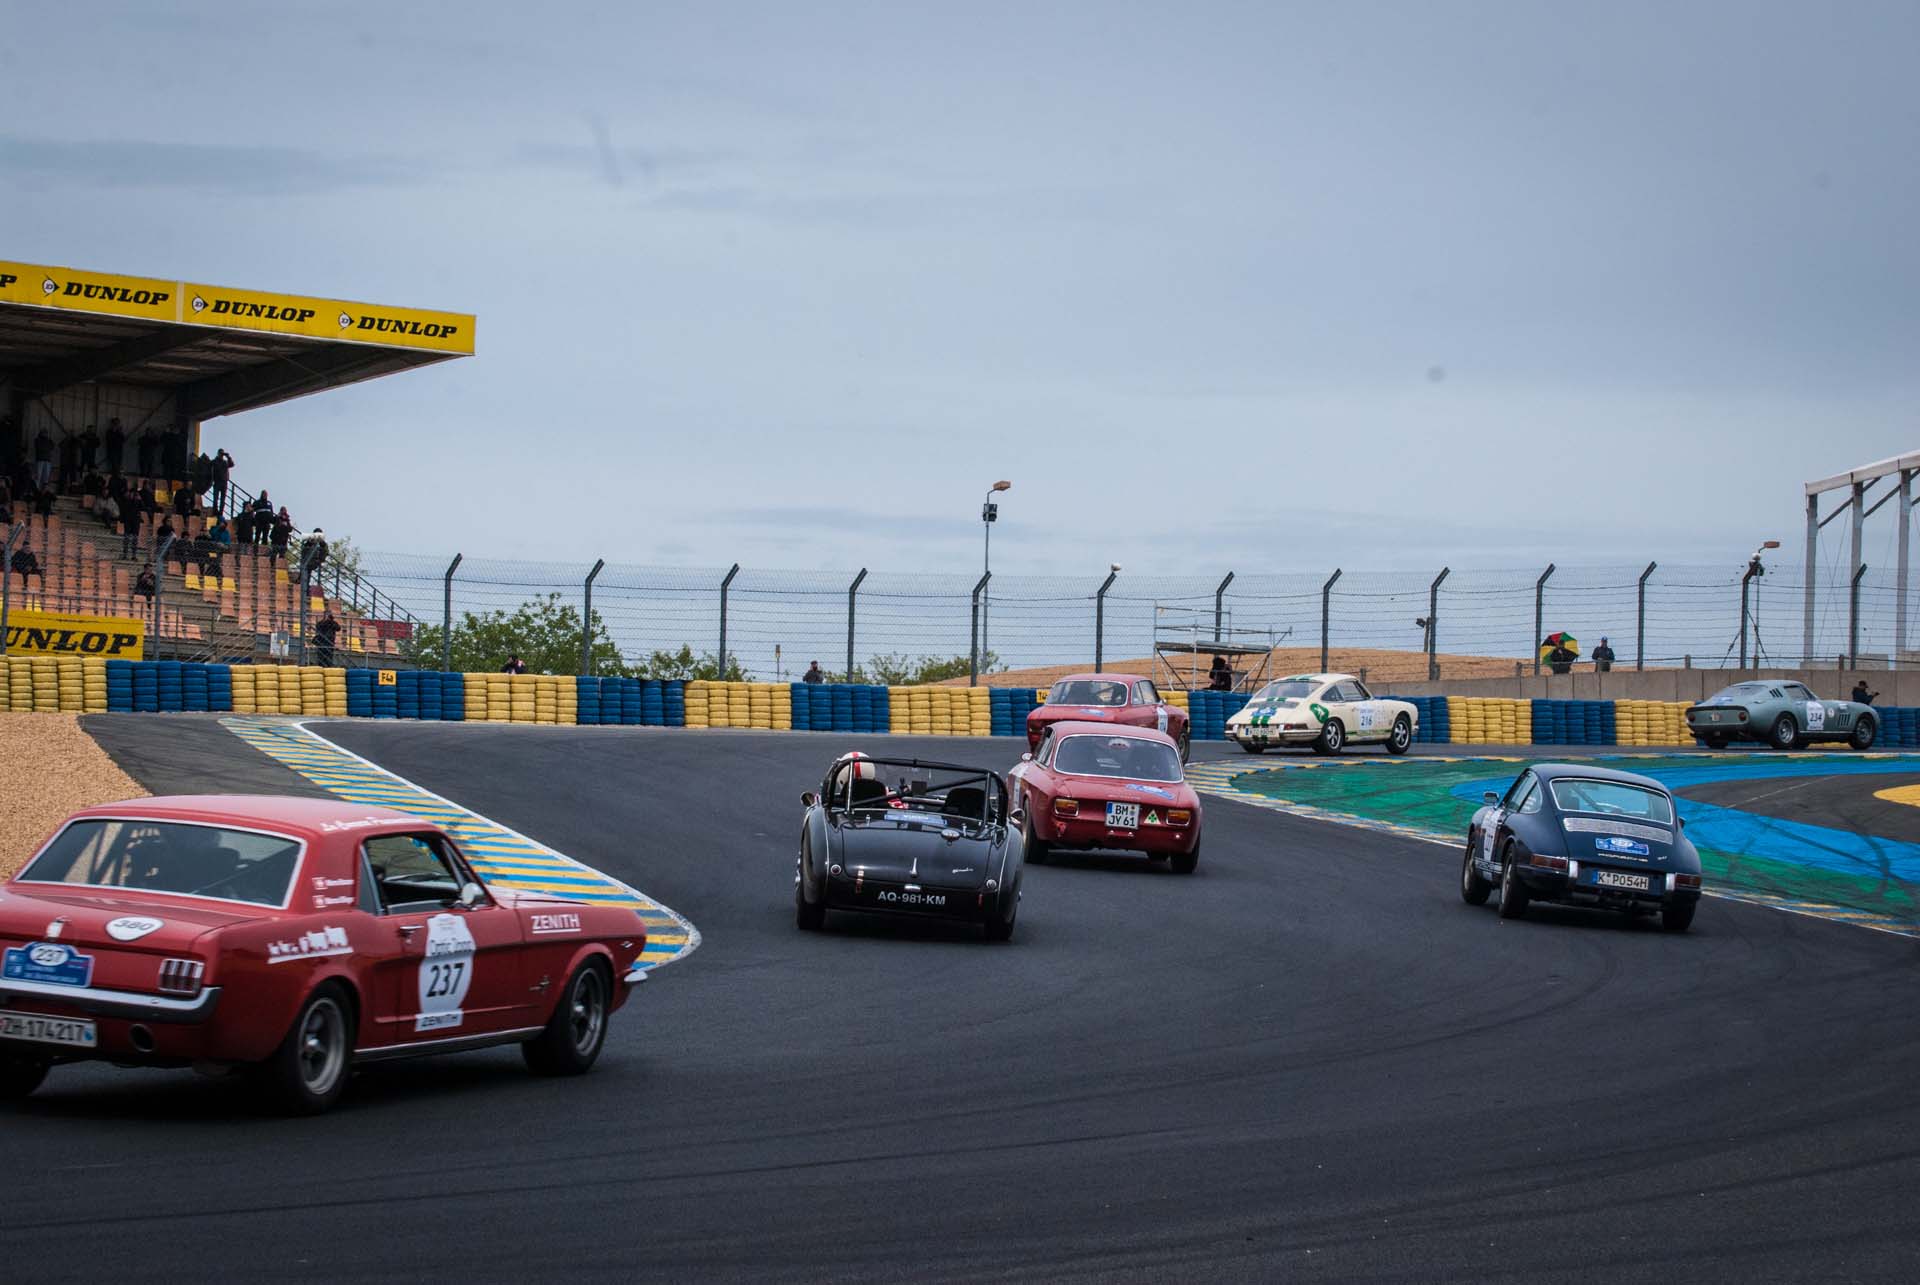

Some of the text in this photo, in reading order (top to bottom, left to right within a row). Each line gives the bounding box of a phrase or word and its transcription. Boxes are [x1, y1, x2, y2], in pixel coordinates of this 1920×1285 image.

[62, 282, 169, 305] DUNLOP
[211, 300, 315, 322] DUNLOP
[357, 316, 457, 338] DUNLOP
[4, 626, 137, 654] UNLOP
[1810, 712, 1823, 722] 234
[1115, 805, 1129, 815] BM
[1108, 815, 1136, 827] JY 61
[114, 920, 154, 931] 380
[531, 914, 580, 930] ZENITH
[427, 962, 464, 997] 237
[421, 1013, 458, 1027] ZENITH
